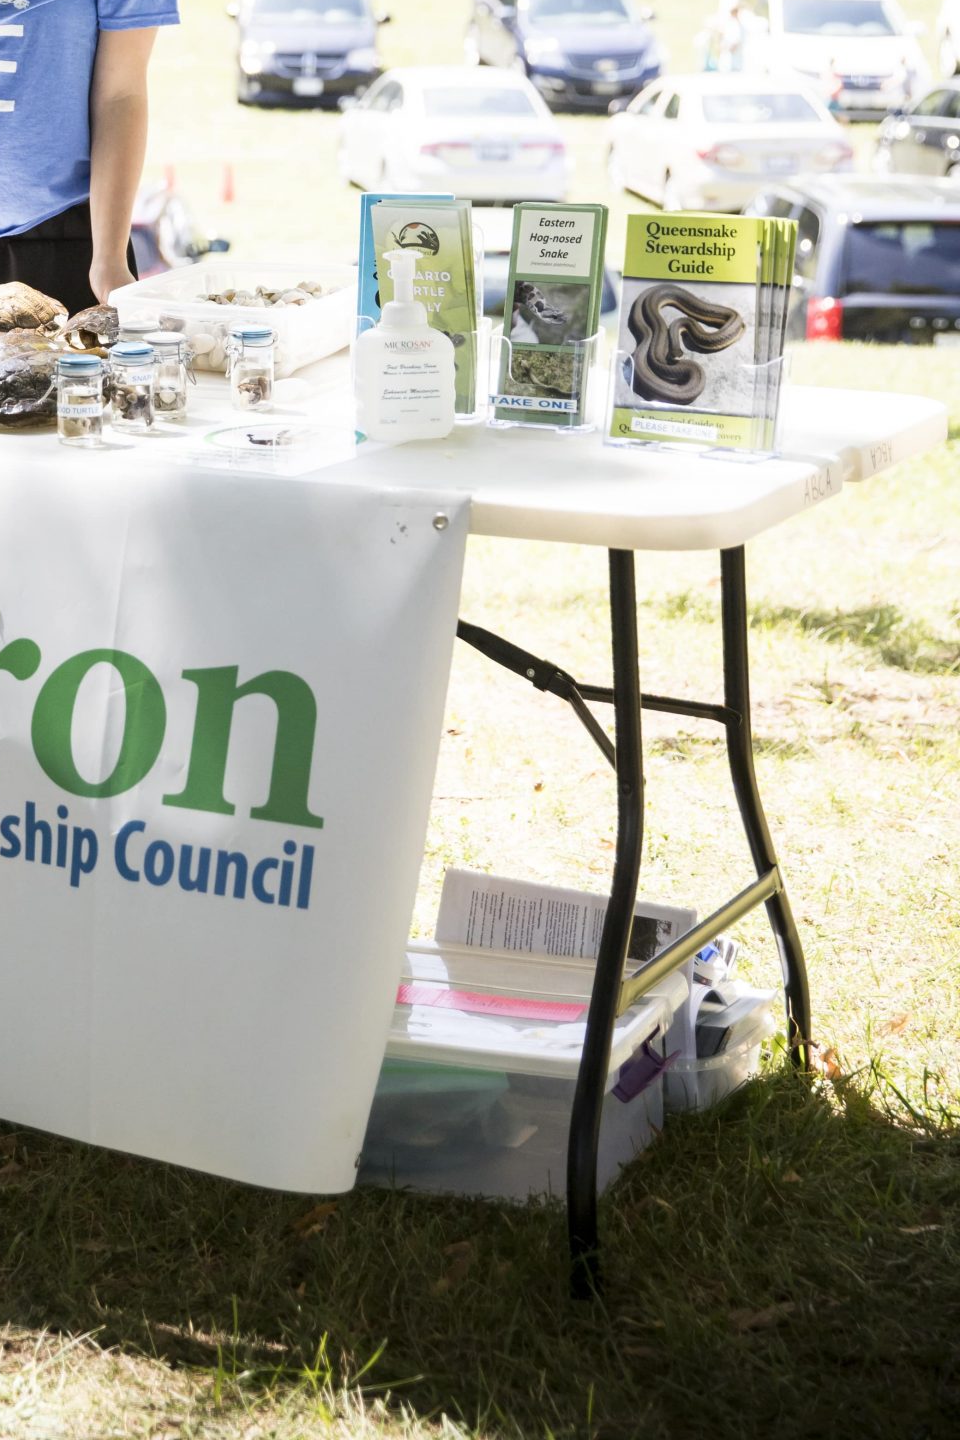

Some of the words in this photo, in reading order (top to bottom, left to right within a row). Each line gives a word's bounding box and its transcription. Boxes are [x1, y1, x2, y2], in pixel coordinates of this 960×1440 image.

[539, 217, 576, 228] Eastern
[646, 221, 738, 239] Queensnake
[529, 232, 583, 244] Hog-nosed
[539, 248, 569, 259] Snake
[645, 239, 736, 261] Stewardship
[667, 258, 714, 274] Guide
[413, 286, 445, 297] RTLE
[489, 395, 533, 407] TAKE
[538, 400, 575, 410] ONE
[634, 419, 669, 433] PLEASE
[671, 424, 692, 435] TAKE
[112, 819, 316, 910] Council
